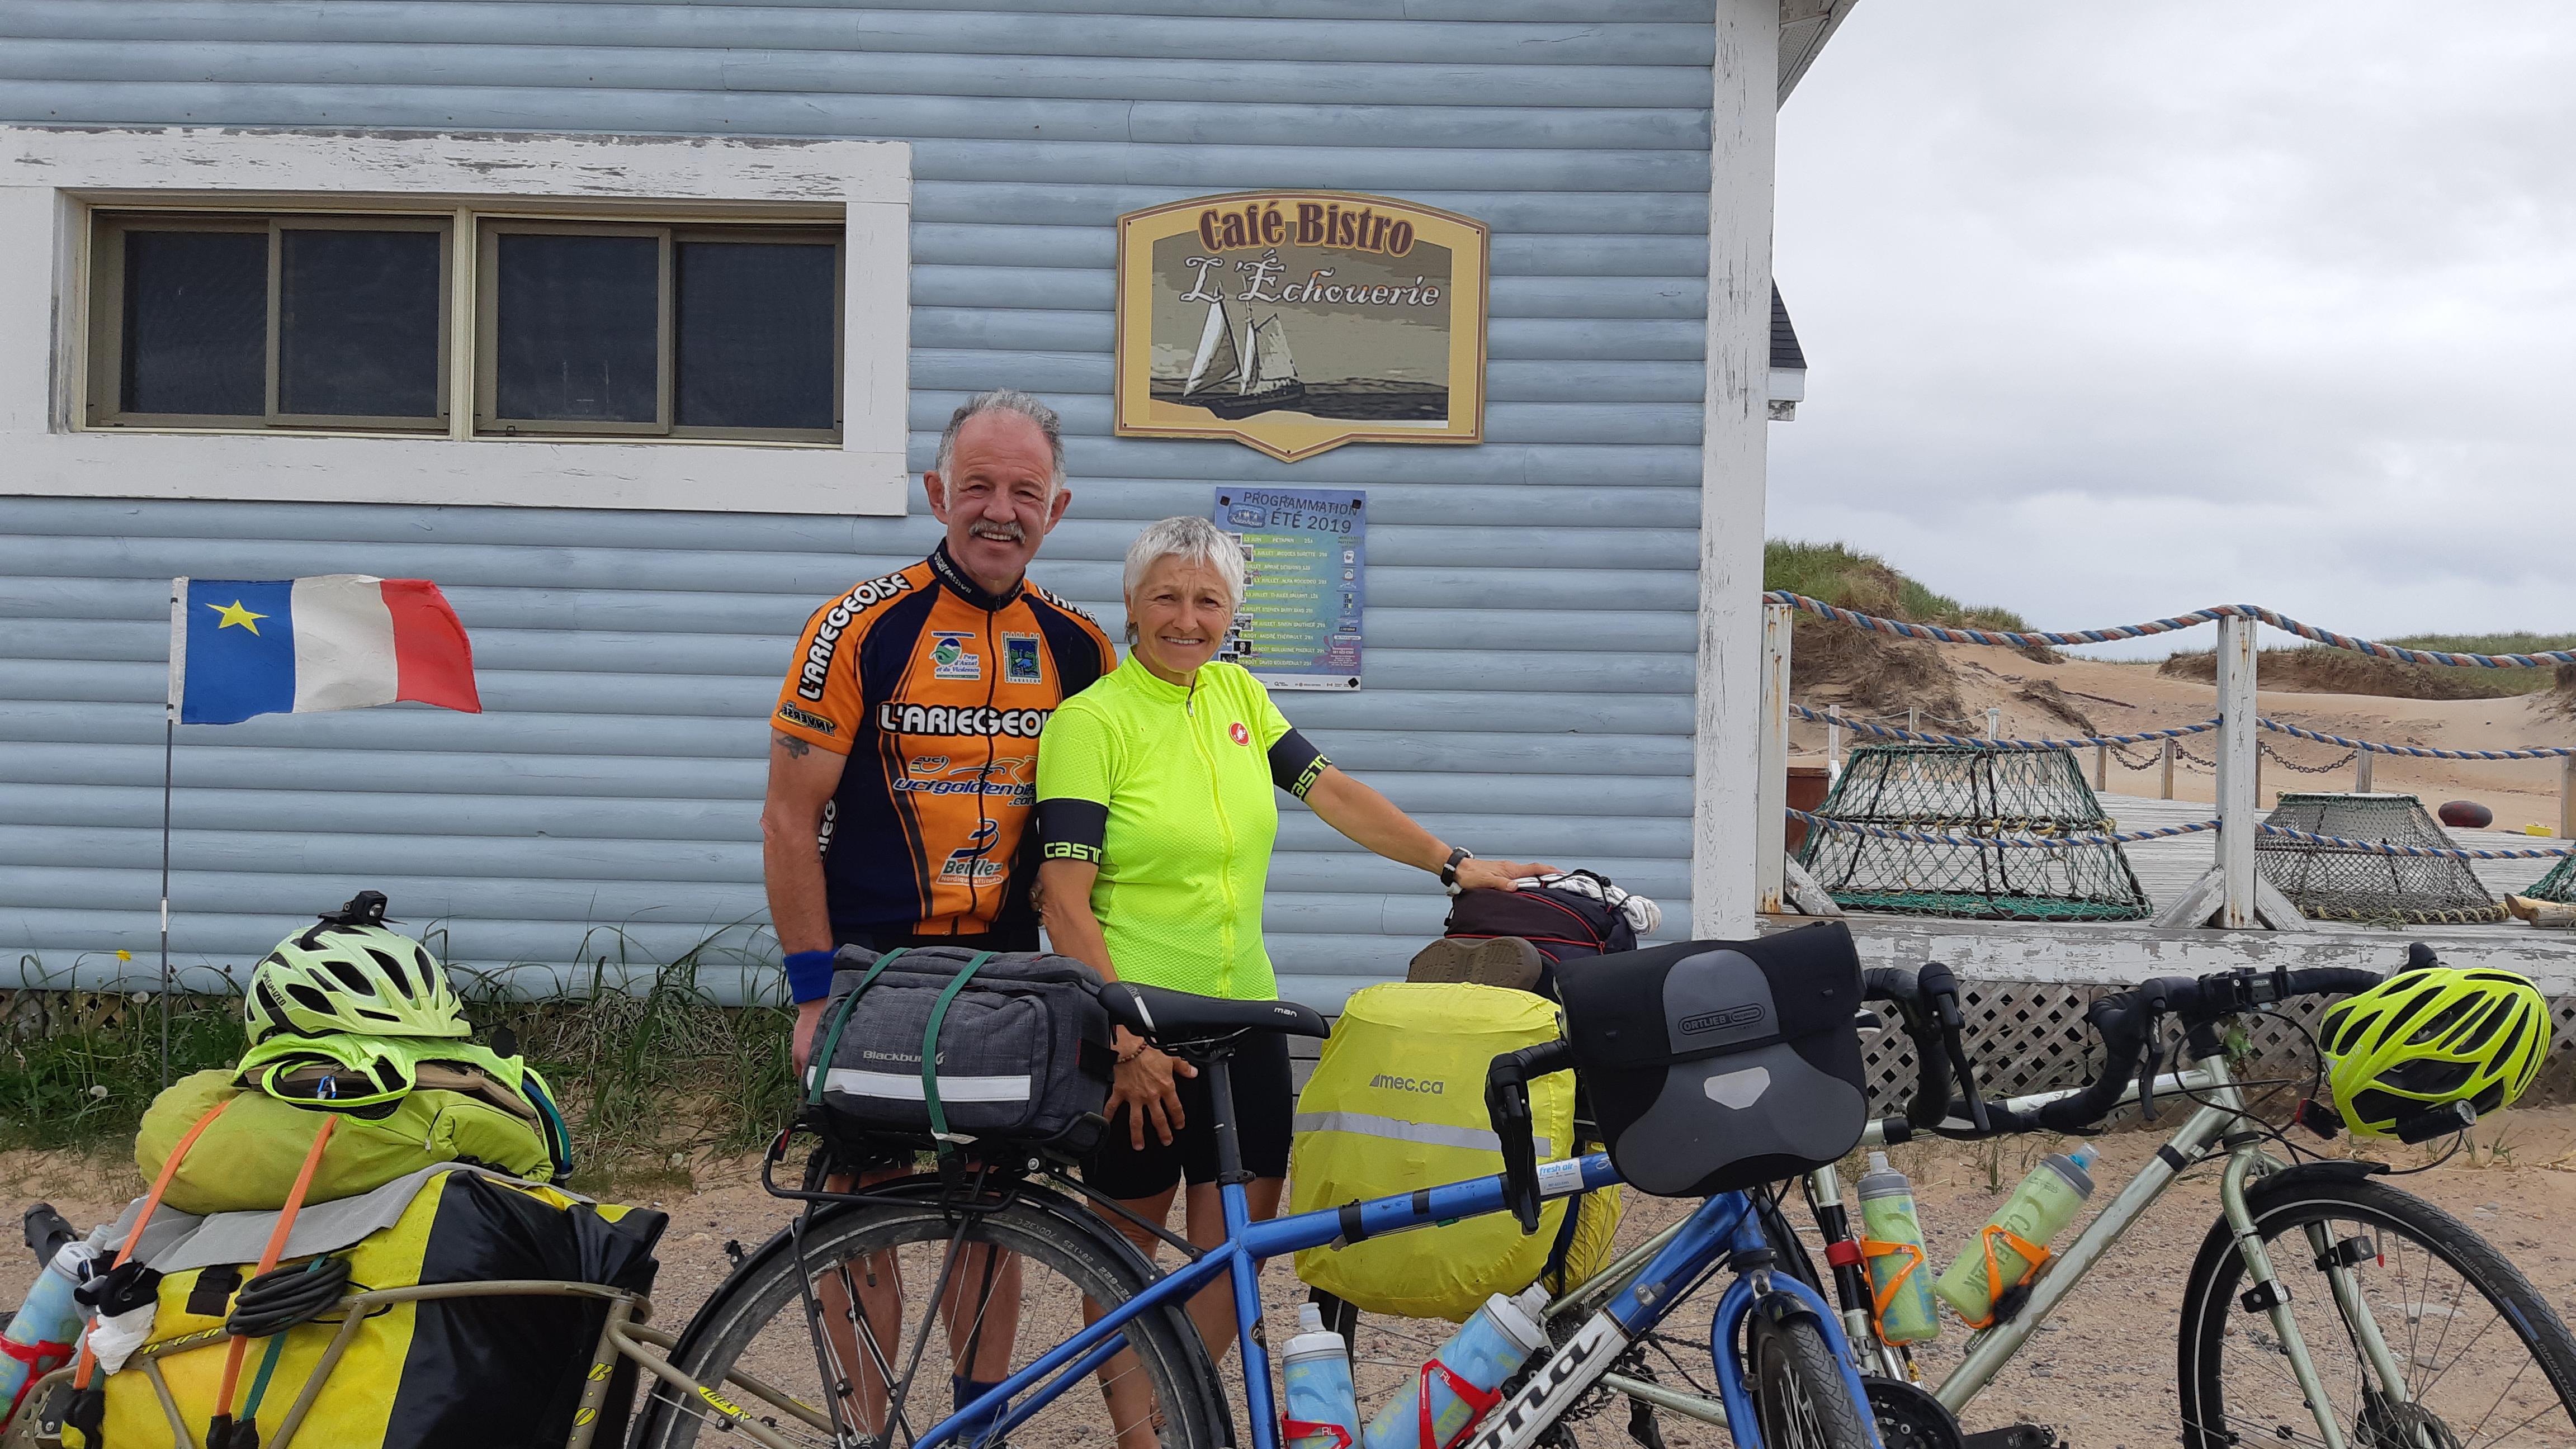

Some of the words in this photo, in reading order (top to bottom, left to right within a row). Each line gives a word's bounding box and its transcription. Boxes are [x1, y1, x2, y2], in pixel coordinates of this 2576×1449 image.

[1199, 201, 1285, 253] Café
[1297, 203, 1415, 257] Bistro
[1244, 491, 1358, 516] PROGRAMMATION
[1271, 508, 1302, 528] ÉTÉ
[1307, 515, 1351, 534] 2019
[799, 574, 911, 699] L'ARIEGEOISE
[881, 704, 1053, 737] L'ARIEGEOI
[1274, 1007, 1297, 1017] man
[1683, 1015, 1727, 1030] ORTLIEB
[1379, 1074, 1444, 1095] mec.ca
[1539, 1164, 1561, 1177] fresh
[1562, 1162, 1574, 1171] air
[2445, 1240, 2504, 1296] SCHWALBE
[1440, 1370, 1451, 1386] RL
[1321, 1426, 1336, 1436] RL
